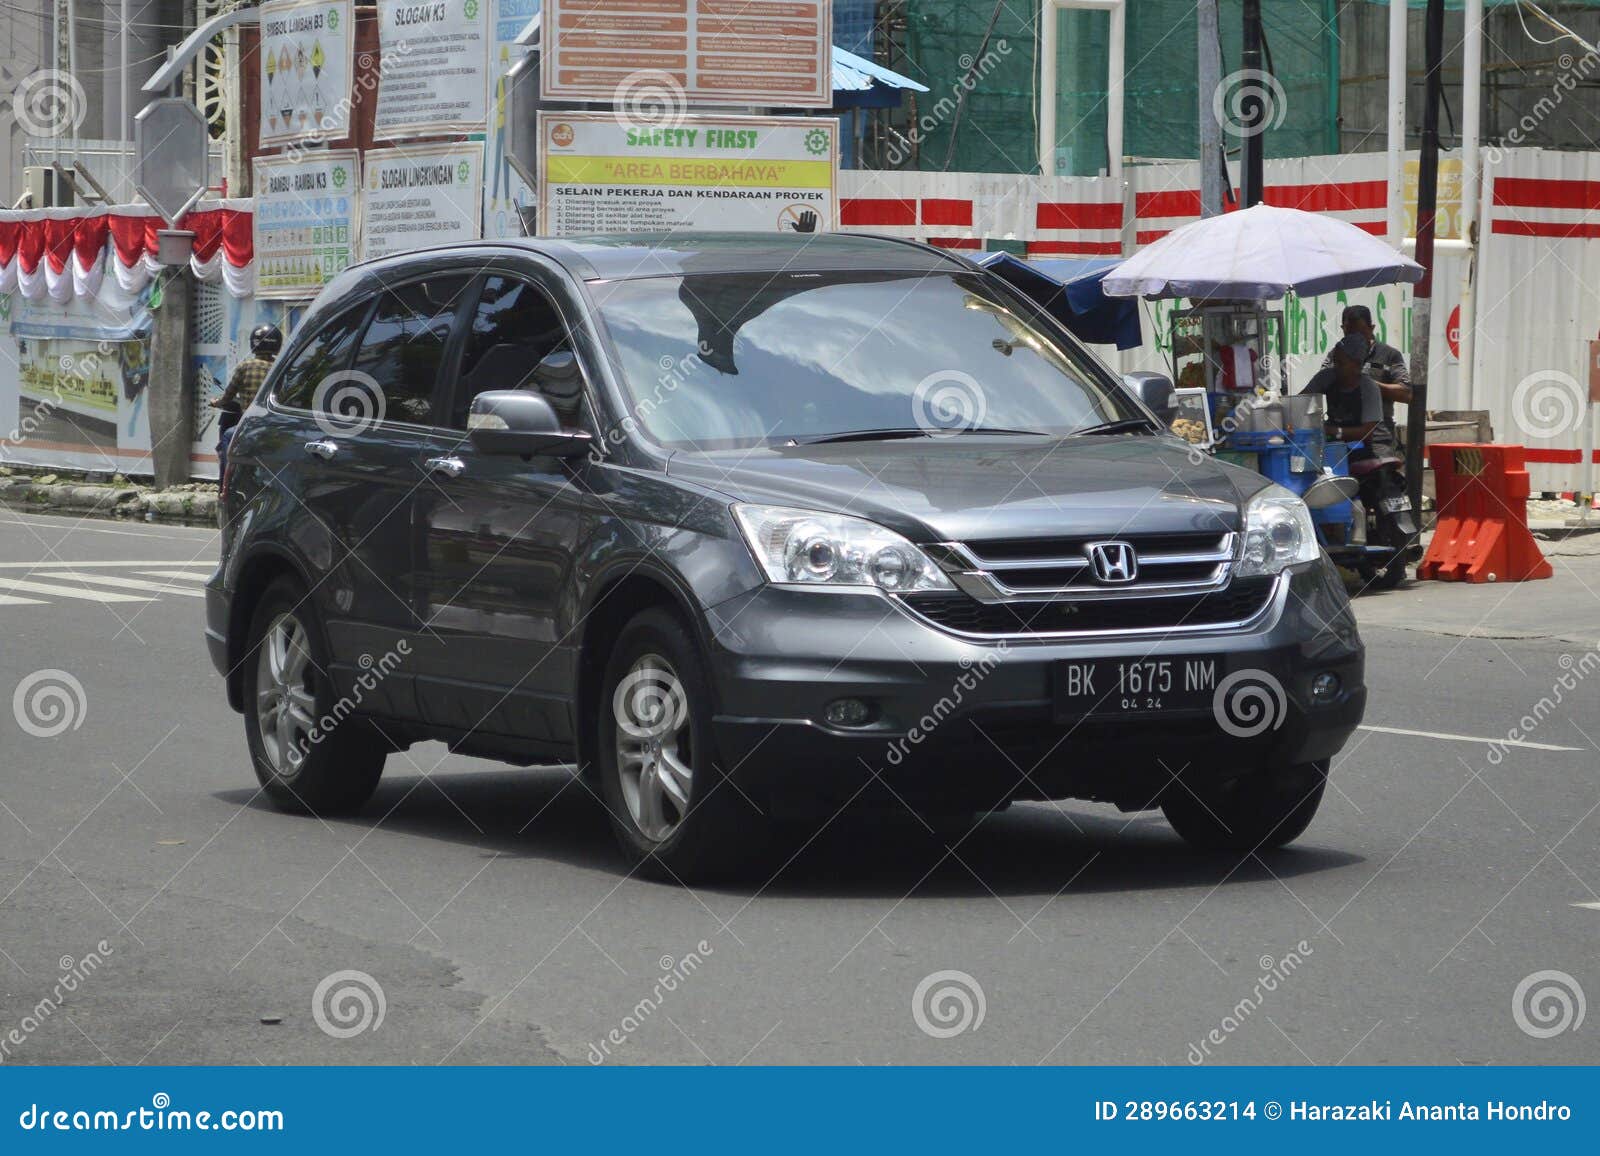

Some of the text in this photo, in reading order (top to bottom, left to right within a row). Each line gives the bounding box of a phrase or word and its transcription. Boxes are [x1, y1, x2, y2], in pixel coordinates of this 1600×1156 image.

[289, 16, 313, 33] LIMBAH
[314, 14, 323, 29] B3
[395, 3, 445, 26] SLOGAN K3
[626, 128, 758, 149] SAFETY FIRST
[270, 175, 290, 193] RAMBU
[295, 173, 315, 191] RAMBU
[316, 172, 327, 190] K3
[382, 164, 453, 189] SLOGAN LINGKUNGAN
[556, 187, 824, 201] SELAIN PEKERJA DAN KENDARAAN PROYEK
[1067, 660, 1216, 697] BK 1675 NM
[1121, 697, 1162, 709] 04 24
